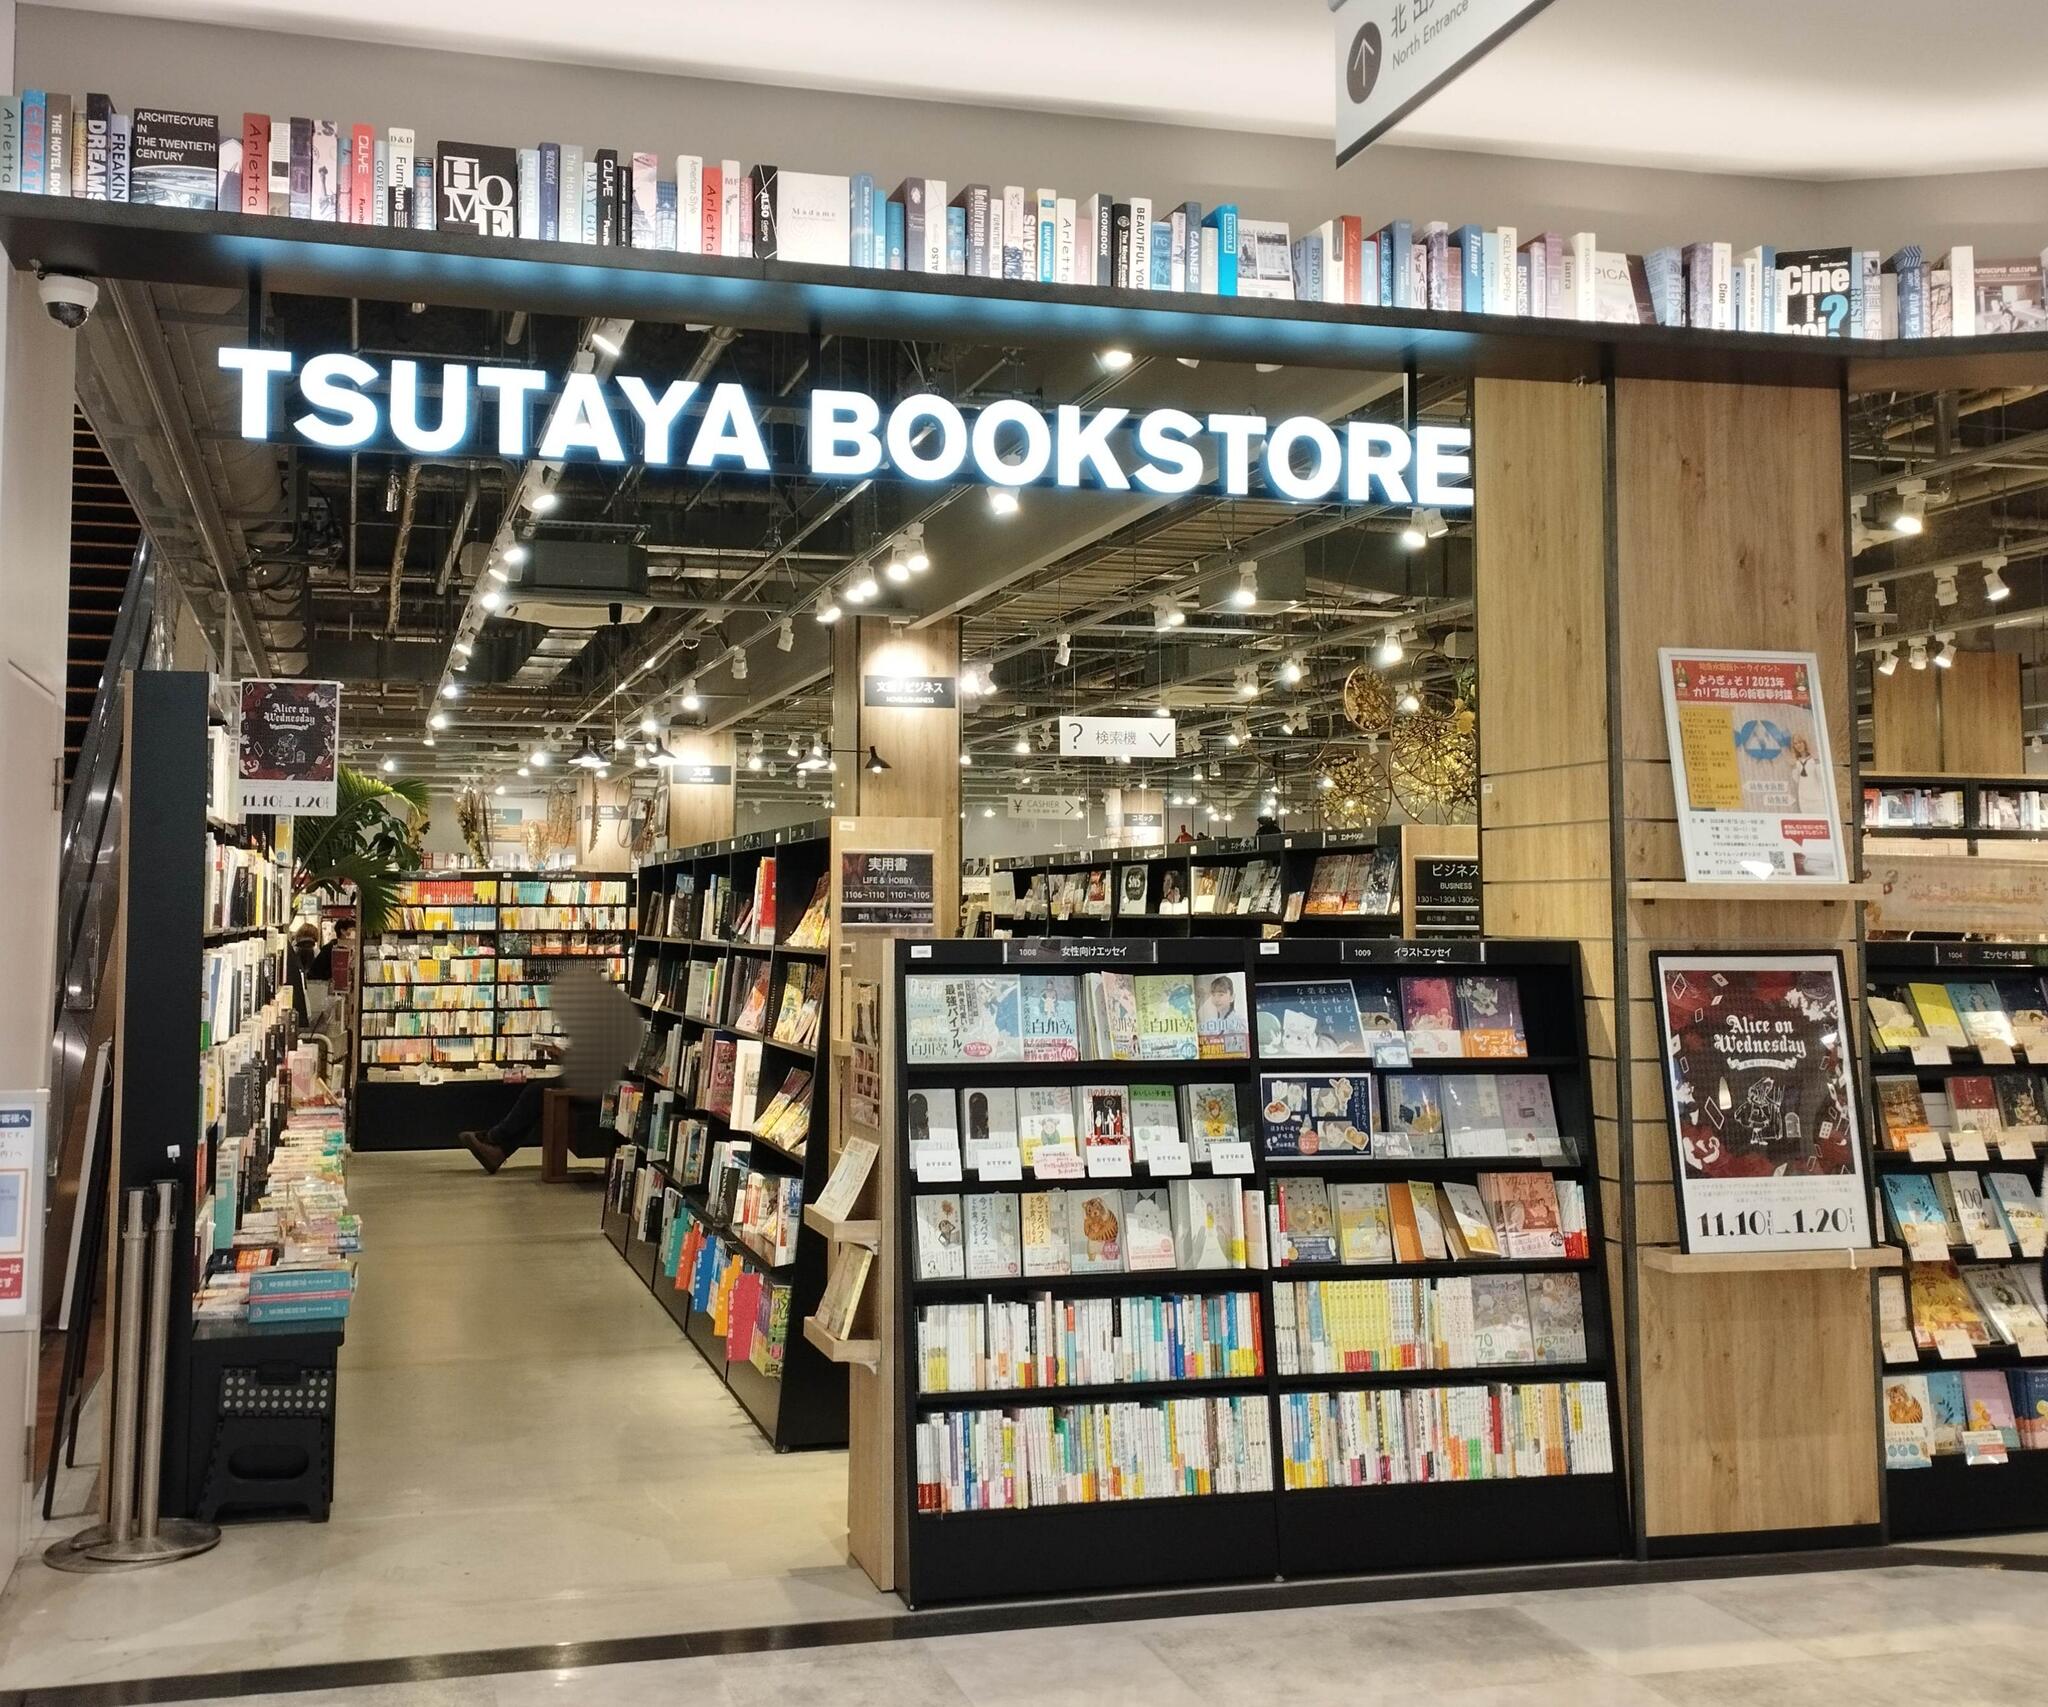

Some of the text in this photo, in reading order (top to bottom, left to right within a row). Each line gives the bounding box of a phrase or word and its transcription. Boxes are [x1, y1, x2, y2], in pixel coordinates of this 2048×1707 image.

[1392, 0, 1469, 70] North Entrance
[51, 114, 62, 134] THE
[137, 124, 148, 133] IN
[2, 108, 15, 184] Arletta
[51, 136, 61, 168] HOTEL
[136, 149, 184, 162] CENTURY
[137, 137, 216, 152] THE TWENTIETH
[248, 124, 262, 207] Arletta
[376, 160, 384, 192] COVER
[394, 156, 407, 211] Furniture
[443, 155, 515, 238] HOME
[586, 171, 598, 207] MAY
[760, 191, 770, 218] ALSO
[792, 208, 836, 217] Madame
[974, 188, 988, 247] Mediterranean
[706, 185, 716, 252] Arletta
[1100, 206, 1109, 257] LOOKBOOK
[1135, 207, 1145, 265] BEAUTIFUL
[1061, 218, 1072, 282] Arletta
[1189, 231, 1199, 284] CANNES
[1470, 233, 1481, 277] Humor
[1503, 233, 1512, 302] KELLY HOPPEN
[1785, 265, 1850, 295] Cine
[1517, 265, 1528, 315] BUSINESS
[1718, 283, 1728, 304] Cine
[1850, 287, 1863, 328] BEST
[218, 346, 1474, 506] TSUTAYA BOOKSTORE
[263, 712, 315, 726] Wednesday
[272, 703, 296, 713] Alice
[1096, 731, 1137, 745] 検索機
[242, 795, 325, 809] 11.10 1.20
[1027, 800, 1060, 808] CASHIER
[868, 857, 908, 871] 実用書
[1432, 864, 1479, 878] ビジネス
[1061, 946, 1127, 957] 女性向けエッセイ
[1354, 948, 1452, 957] 1009 イラストエッセイ
[1982, 950, 2027, 960] エッセイ・随筆
[1032, 1018, 1075, 1035] 白川さん
[1150, 1018, 1195, 1033] 白川さん
[1725, 1014, 1794, 1034] Alice on
[1713, 1033, 1808, 1058] Wednesday
[1958, 1189, 1983, 1208] 100
[1697, 1208, 1848, 1237] 11.10 1.20
